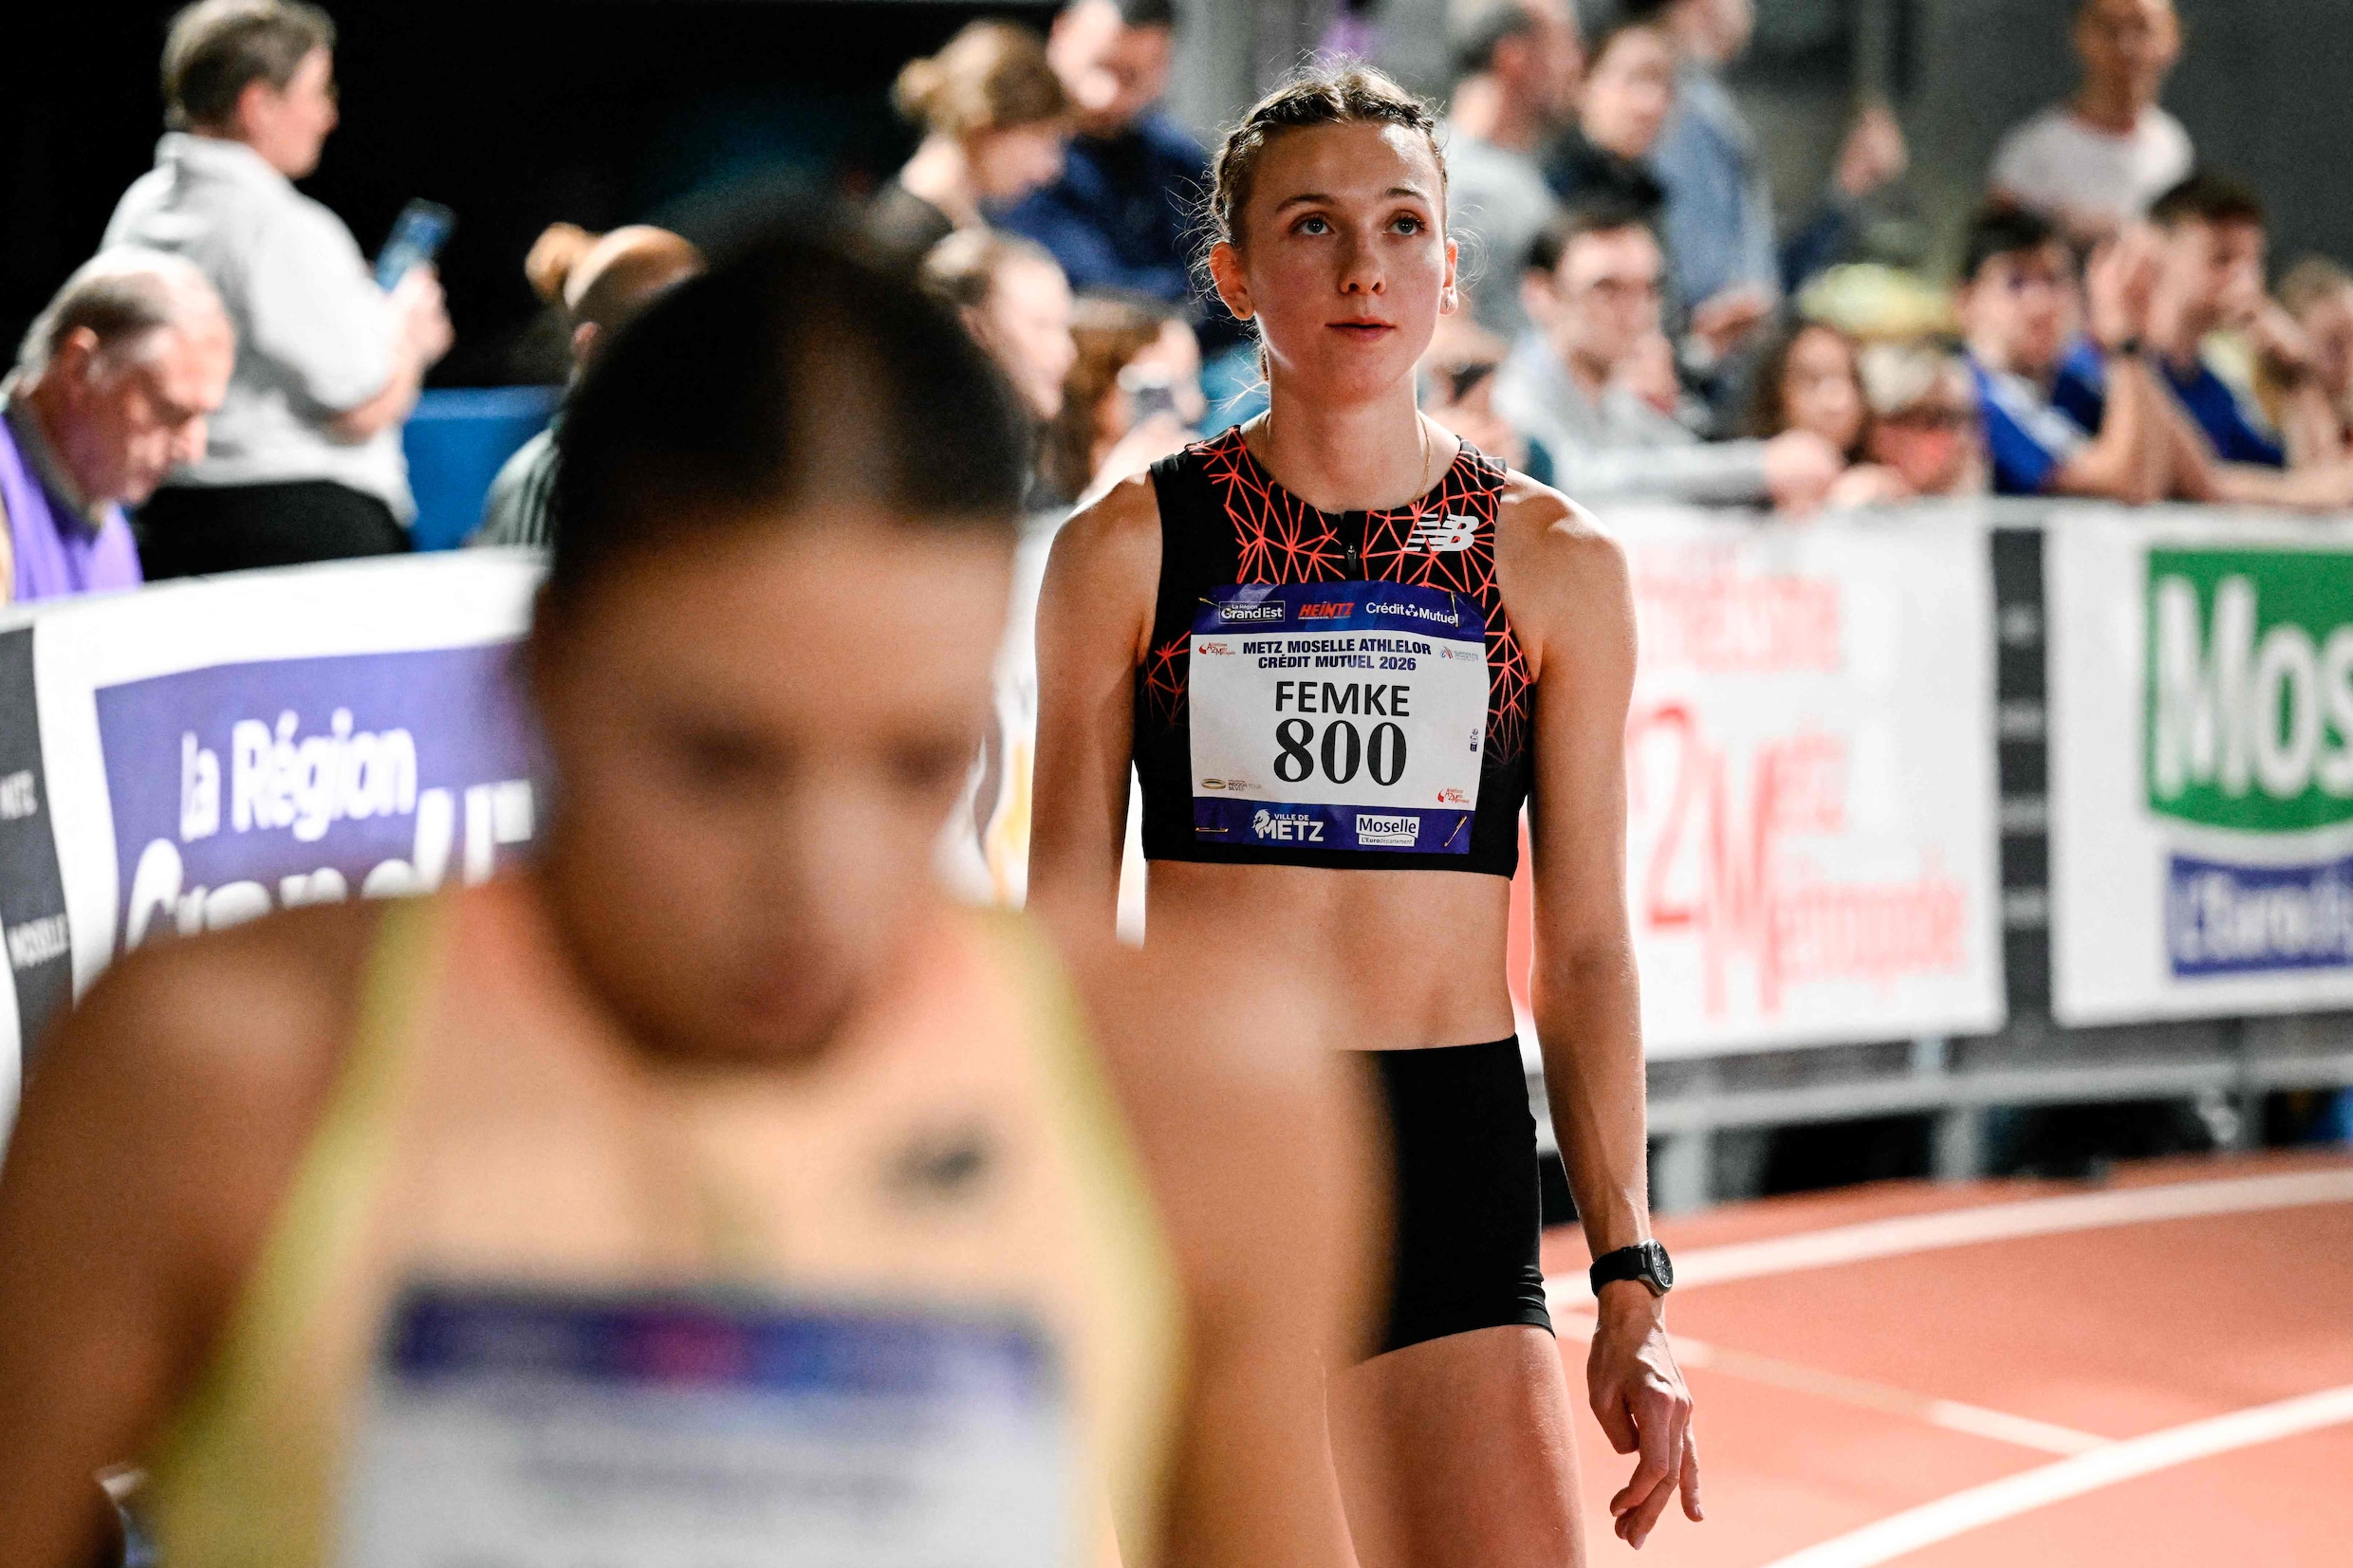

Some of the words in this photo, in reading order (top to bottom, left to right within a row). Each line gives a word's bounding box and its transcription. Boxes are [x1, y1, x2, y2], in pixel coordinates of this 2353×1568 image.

[1365, 602, 1405, 615] Crédit
[1418, 607, 1459, 624] Mutuel
[1243, 641, 1283, 655] METZ
[1288, 639, 1355, 654] MOSELLE
[1359, 638, 1432, 655] ATHLELOR
[1258, 654, 1311, 669] CRÉDIT
[1315, 655, 1375, 669] MUTUEL
[1379, 656, 1417, 671] 2026
[1275, 681, 1410, 717] FEMKE
[1273, 718, 1407, 786] 800
[232, 707, 417, 841] Région
[1257, 820, 1325, 842] METZ
[1359, 818, 1417, 834] Moselle
